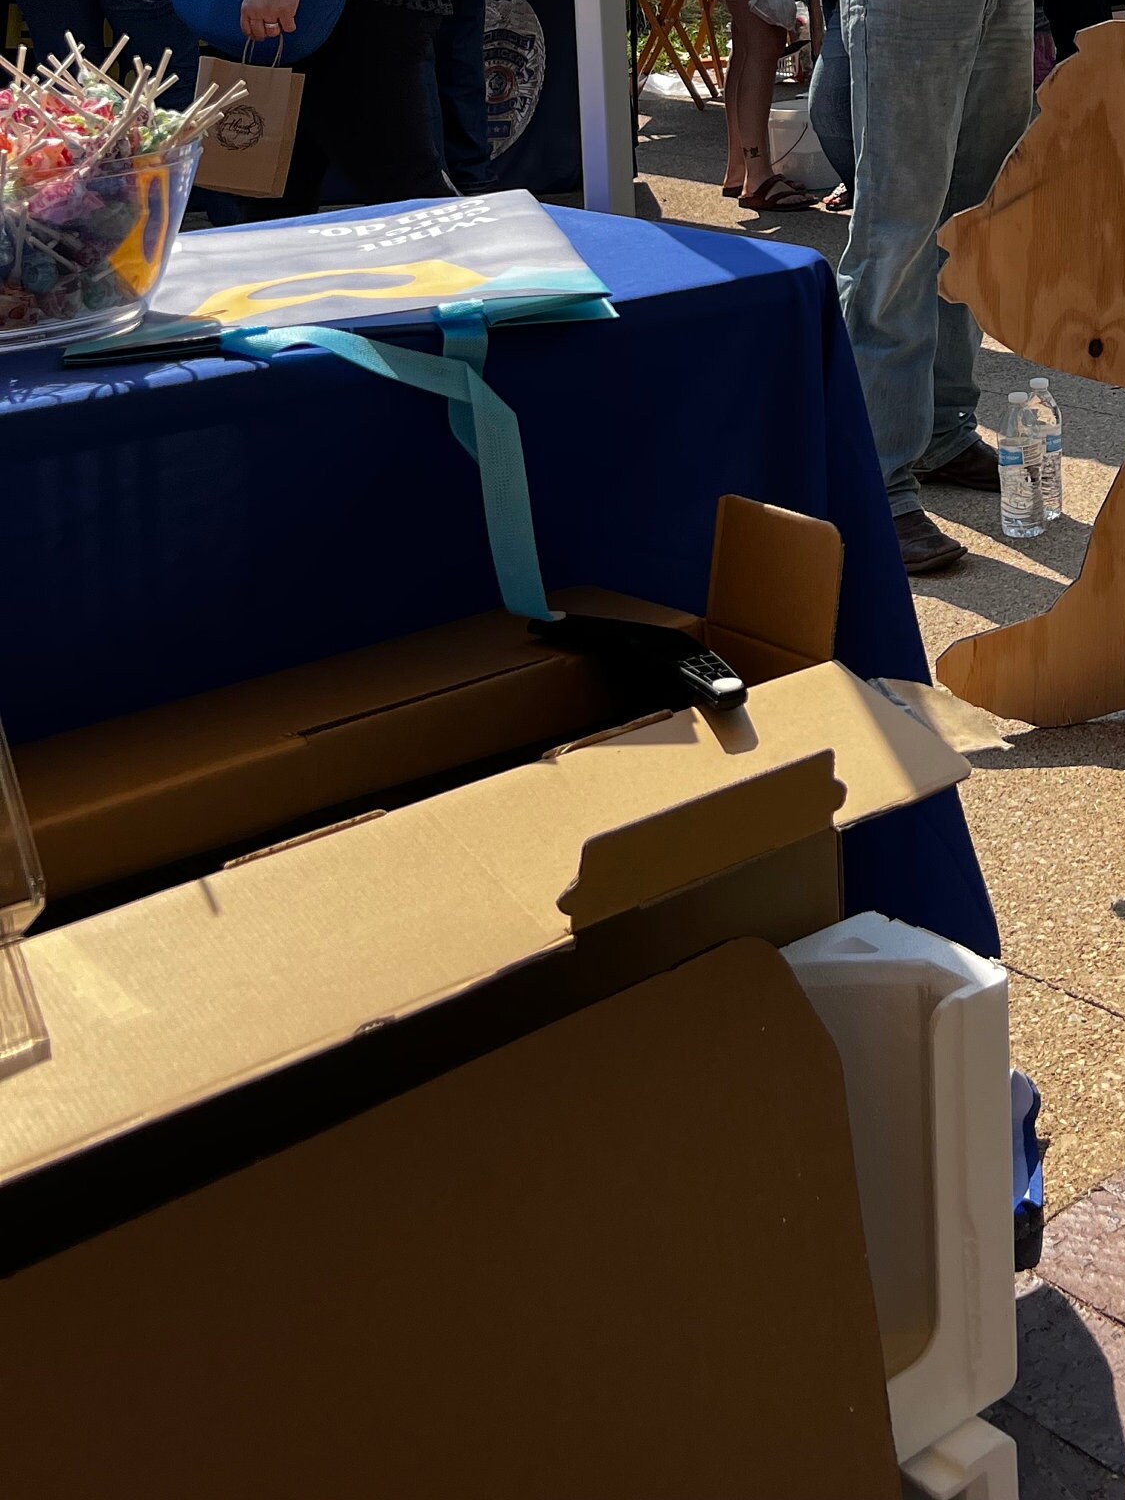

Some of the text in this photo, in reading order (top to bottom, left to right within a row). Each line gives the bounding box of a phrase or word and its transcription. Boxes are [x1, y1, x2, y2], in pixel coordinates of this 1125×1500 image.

[308, 199, 485, 237] can do.
[357, 216, 500, 252] what
[385, 206, 491, 237] care
